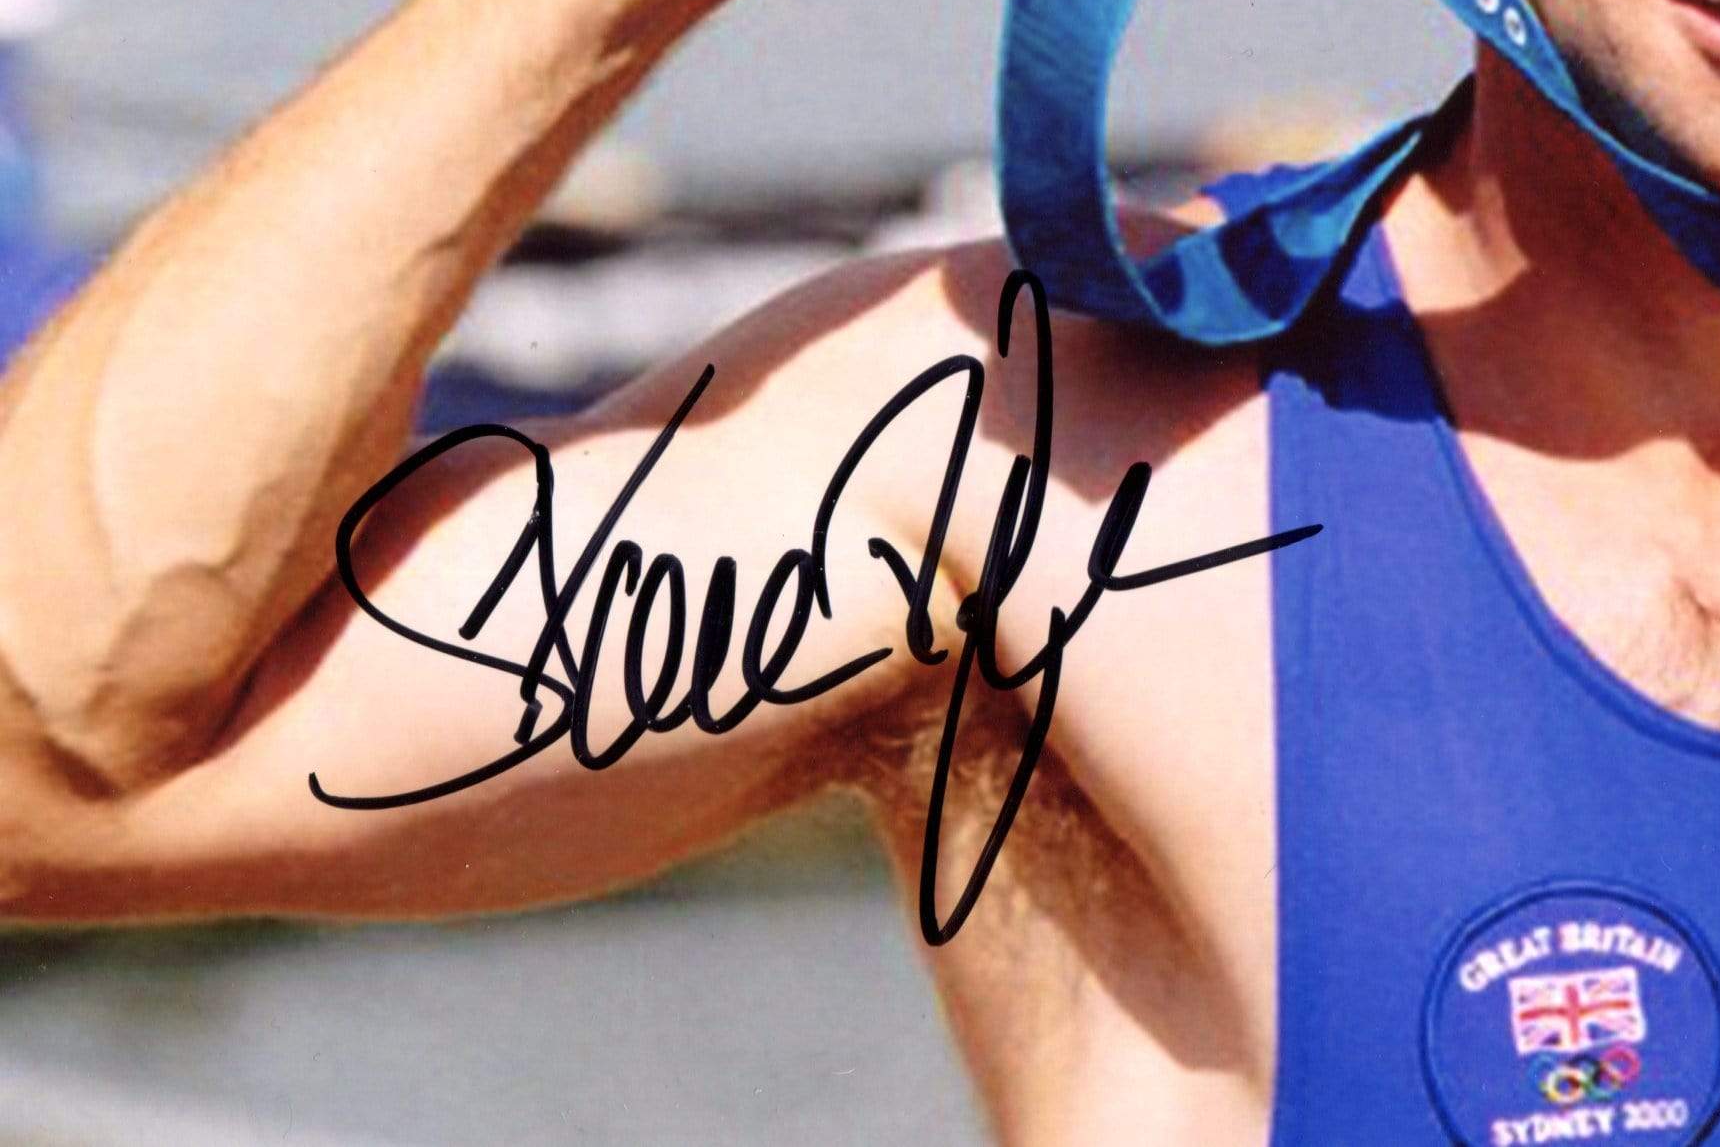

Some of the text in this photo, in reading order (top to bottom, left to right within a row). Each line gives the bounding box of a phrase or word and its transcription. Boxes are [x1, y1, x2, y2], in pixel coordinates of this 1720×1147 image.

[1459, 920, 1682, 992] GREAT BRITAIN
[1491, 1099, 1690, 1146] SYDNEY 2000
